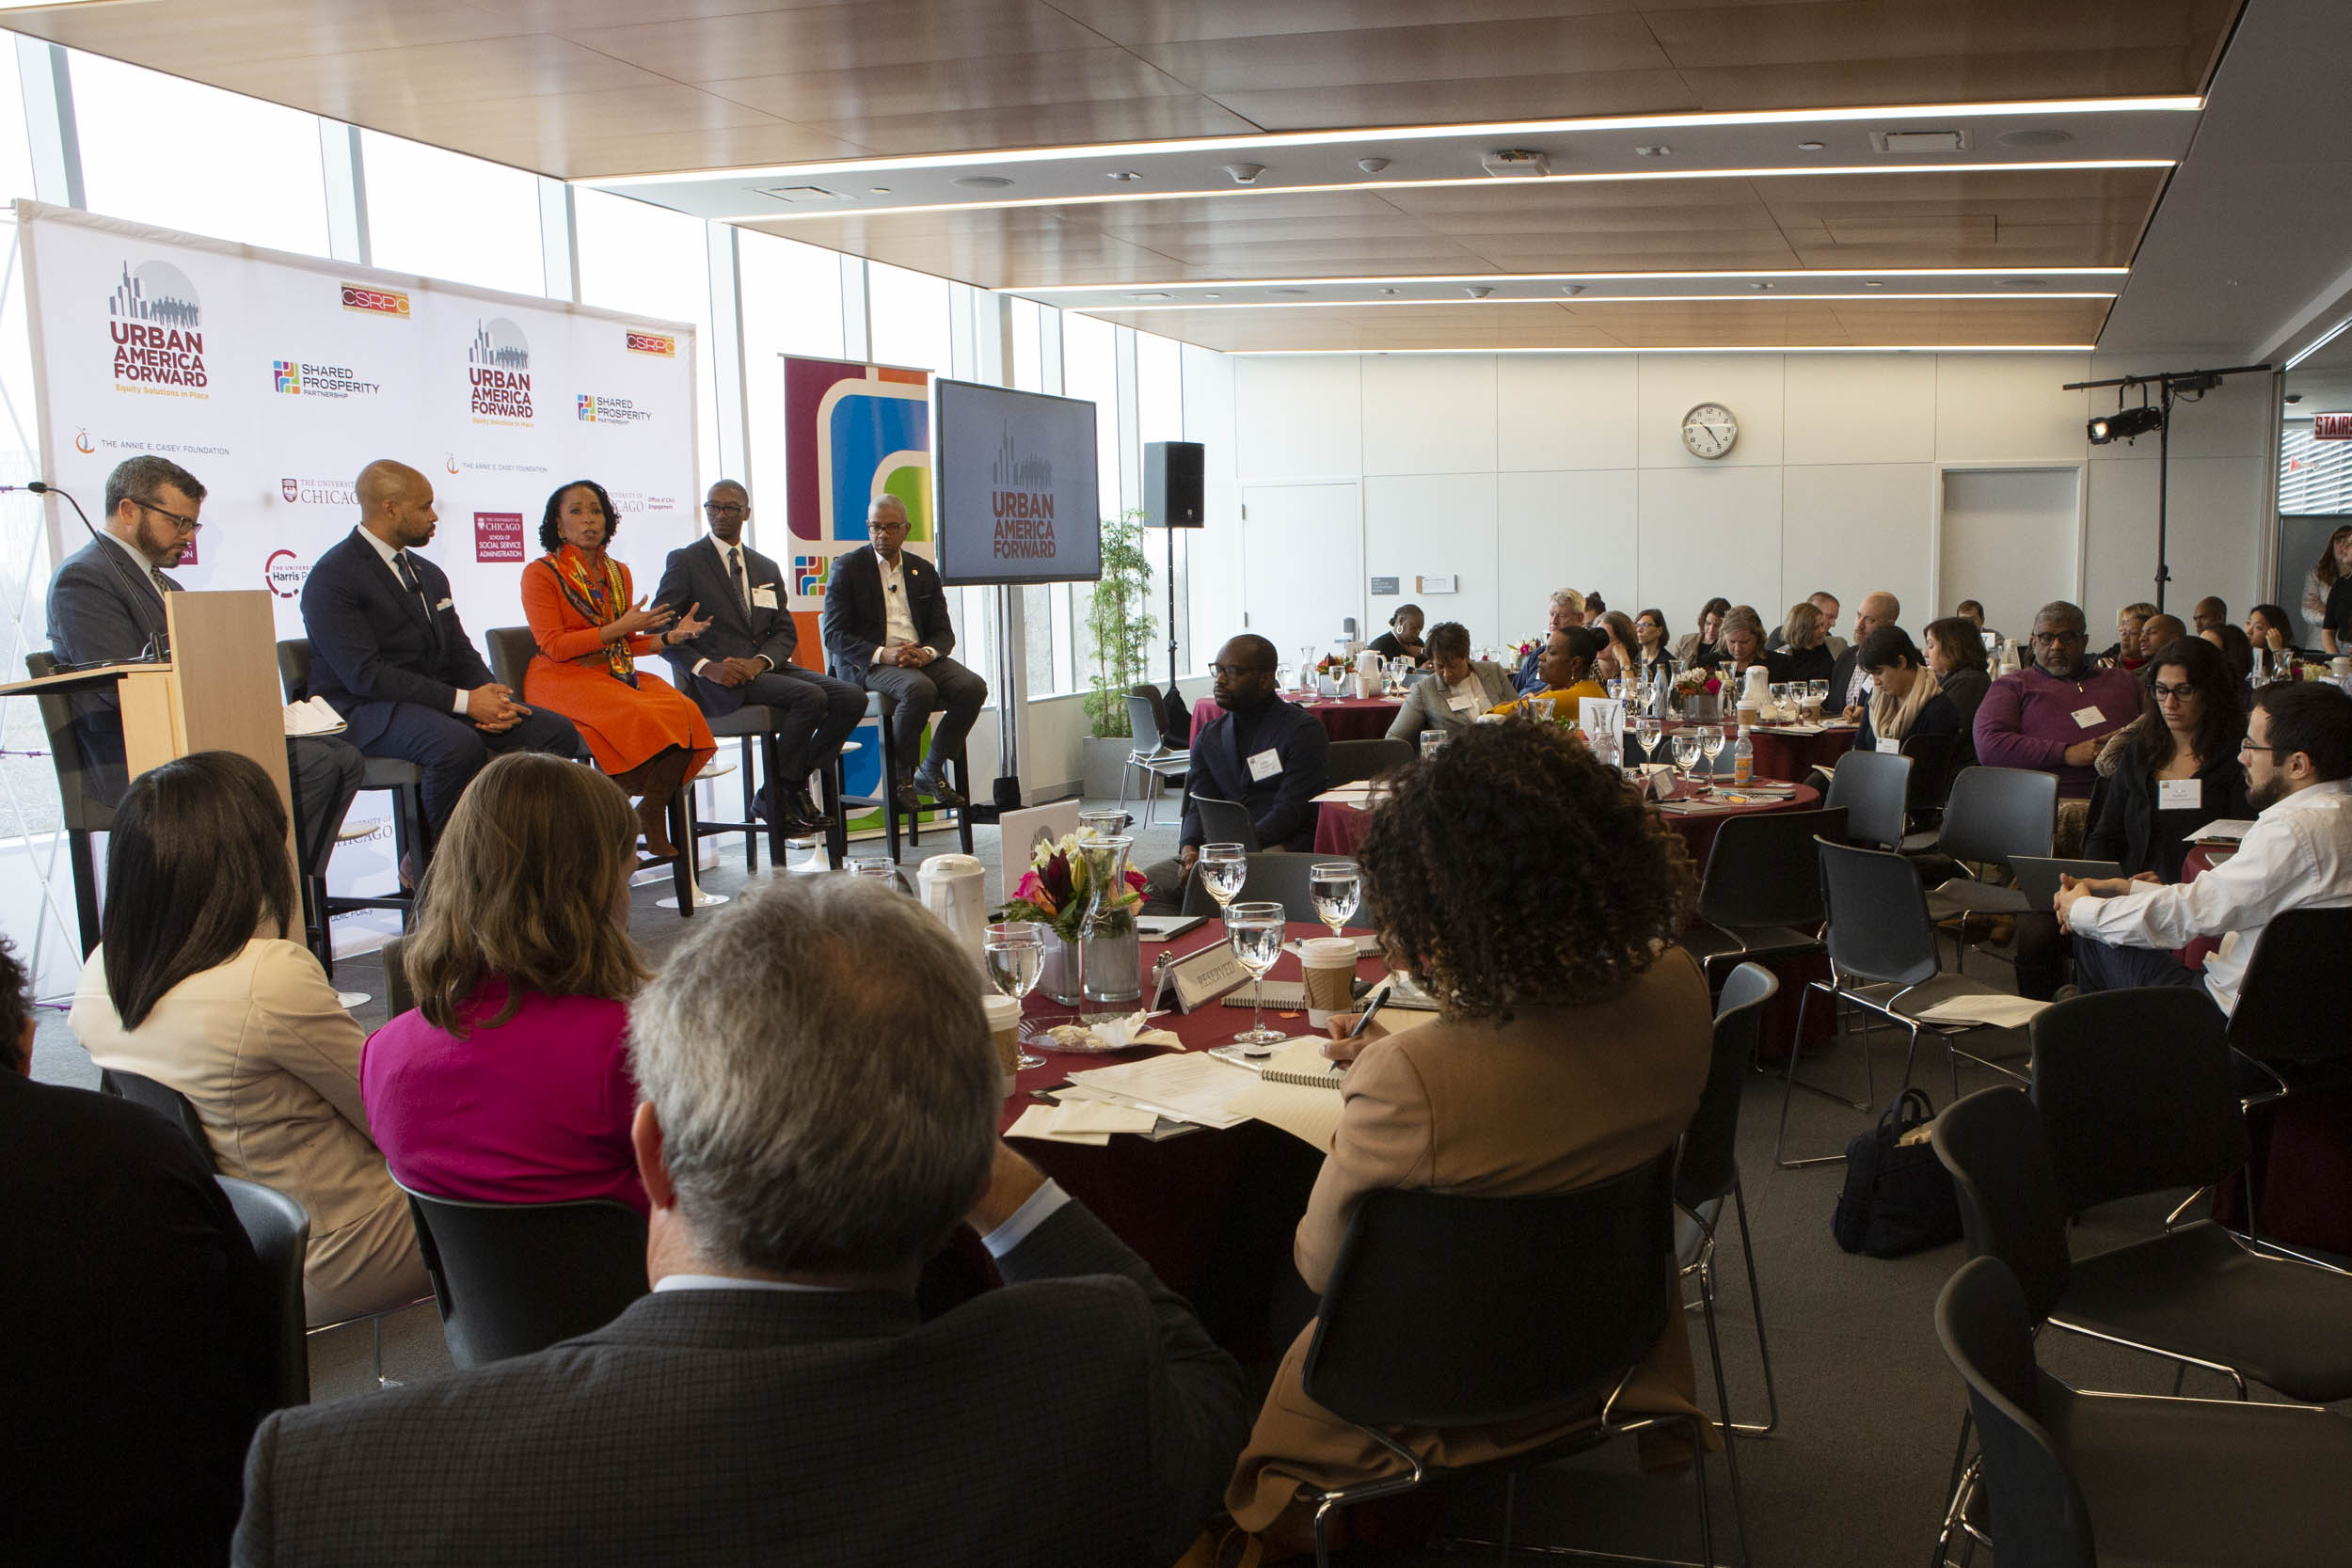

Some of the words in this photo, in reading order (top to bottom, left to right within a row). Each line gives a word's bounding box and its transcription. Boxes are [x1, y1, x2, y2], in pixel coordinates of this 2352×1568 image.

[342, 289, 408, 312] CSRPC
[110, 321, 203, 355] URBAN
[114, 345, 205, 372] AMERICA
[114, 362, 208, 388] FORWARD
[302, 363, 354, 379] SHARED
[469, 367, 531, 391] URBAN
[115, 383, 141, 394] Equity
[143, 386, 180, 397] Solutions
[181, 389, 188, 398] in
[189, 390, 209, 400] Place
[303, 376, 380, 395] PROSPERITY
[303, 389, 349, 399] PARTNERSHIP
[471, 386, 532, 405] AMERICA
[596, 396, 633, 409] SHARED
[471, 401, 533, 419] FORWARD
[597, 406, 652, 421] PROSPERITY
[101, 439, 118, 449] THE
[120, 441, 144, 450] ANNIE
[156, 443, 181, 452] CASEY
[183, 445, 230, 455] FOUNDATION
[300, 479, 315, 487] THE
[318, 480, 356, 488] UNIVERSIT
[301, 489, 358, 505] CHICAG
[993, 491, 1055, 519] URBAN
[485, 522, 521, 531] CHICAGO
[993, 518, 1056, 540] AMERICA
[479, 541, 499, 549] SOCIAL
[500, 541, 522, 549] SERVICE
[993, 540, 1057, 559] FORWARD
[273, 571, 300, 581] Harris
[1197, 961, 1235, 990] RESERVED
